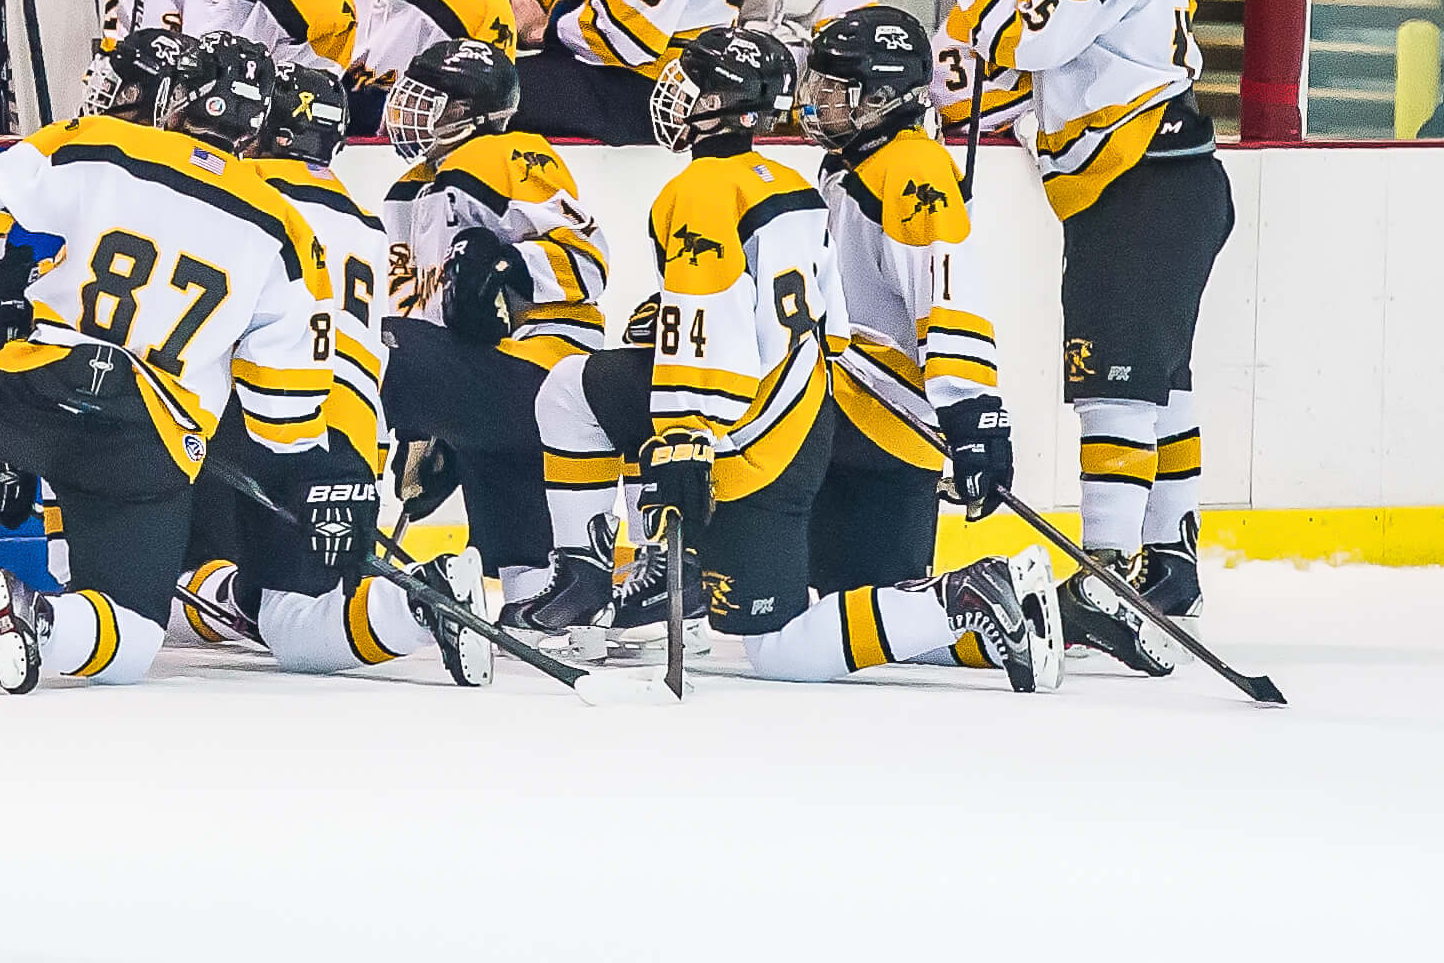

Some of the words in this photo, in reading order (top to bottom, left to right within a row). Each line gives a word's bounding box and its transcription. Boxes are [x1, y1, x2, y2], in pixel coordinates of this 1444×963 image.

[937, 47, 968, 92] 3
[77, 227, 232, 378] 87
[309, 311, 331, 362] 8
[659, 304, 707, 359] 84
